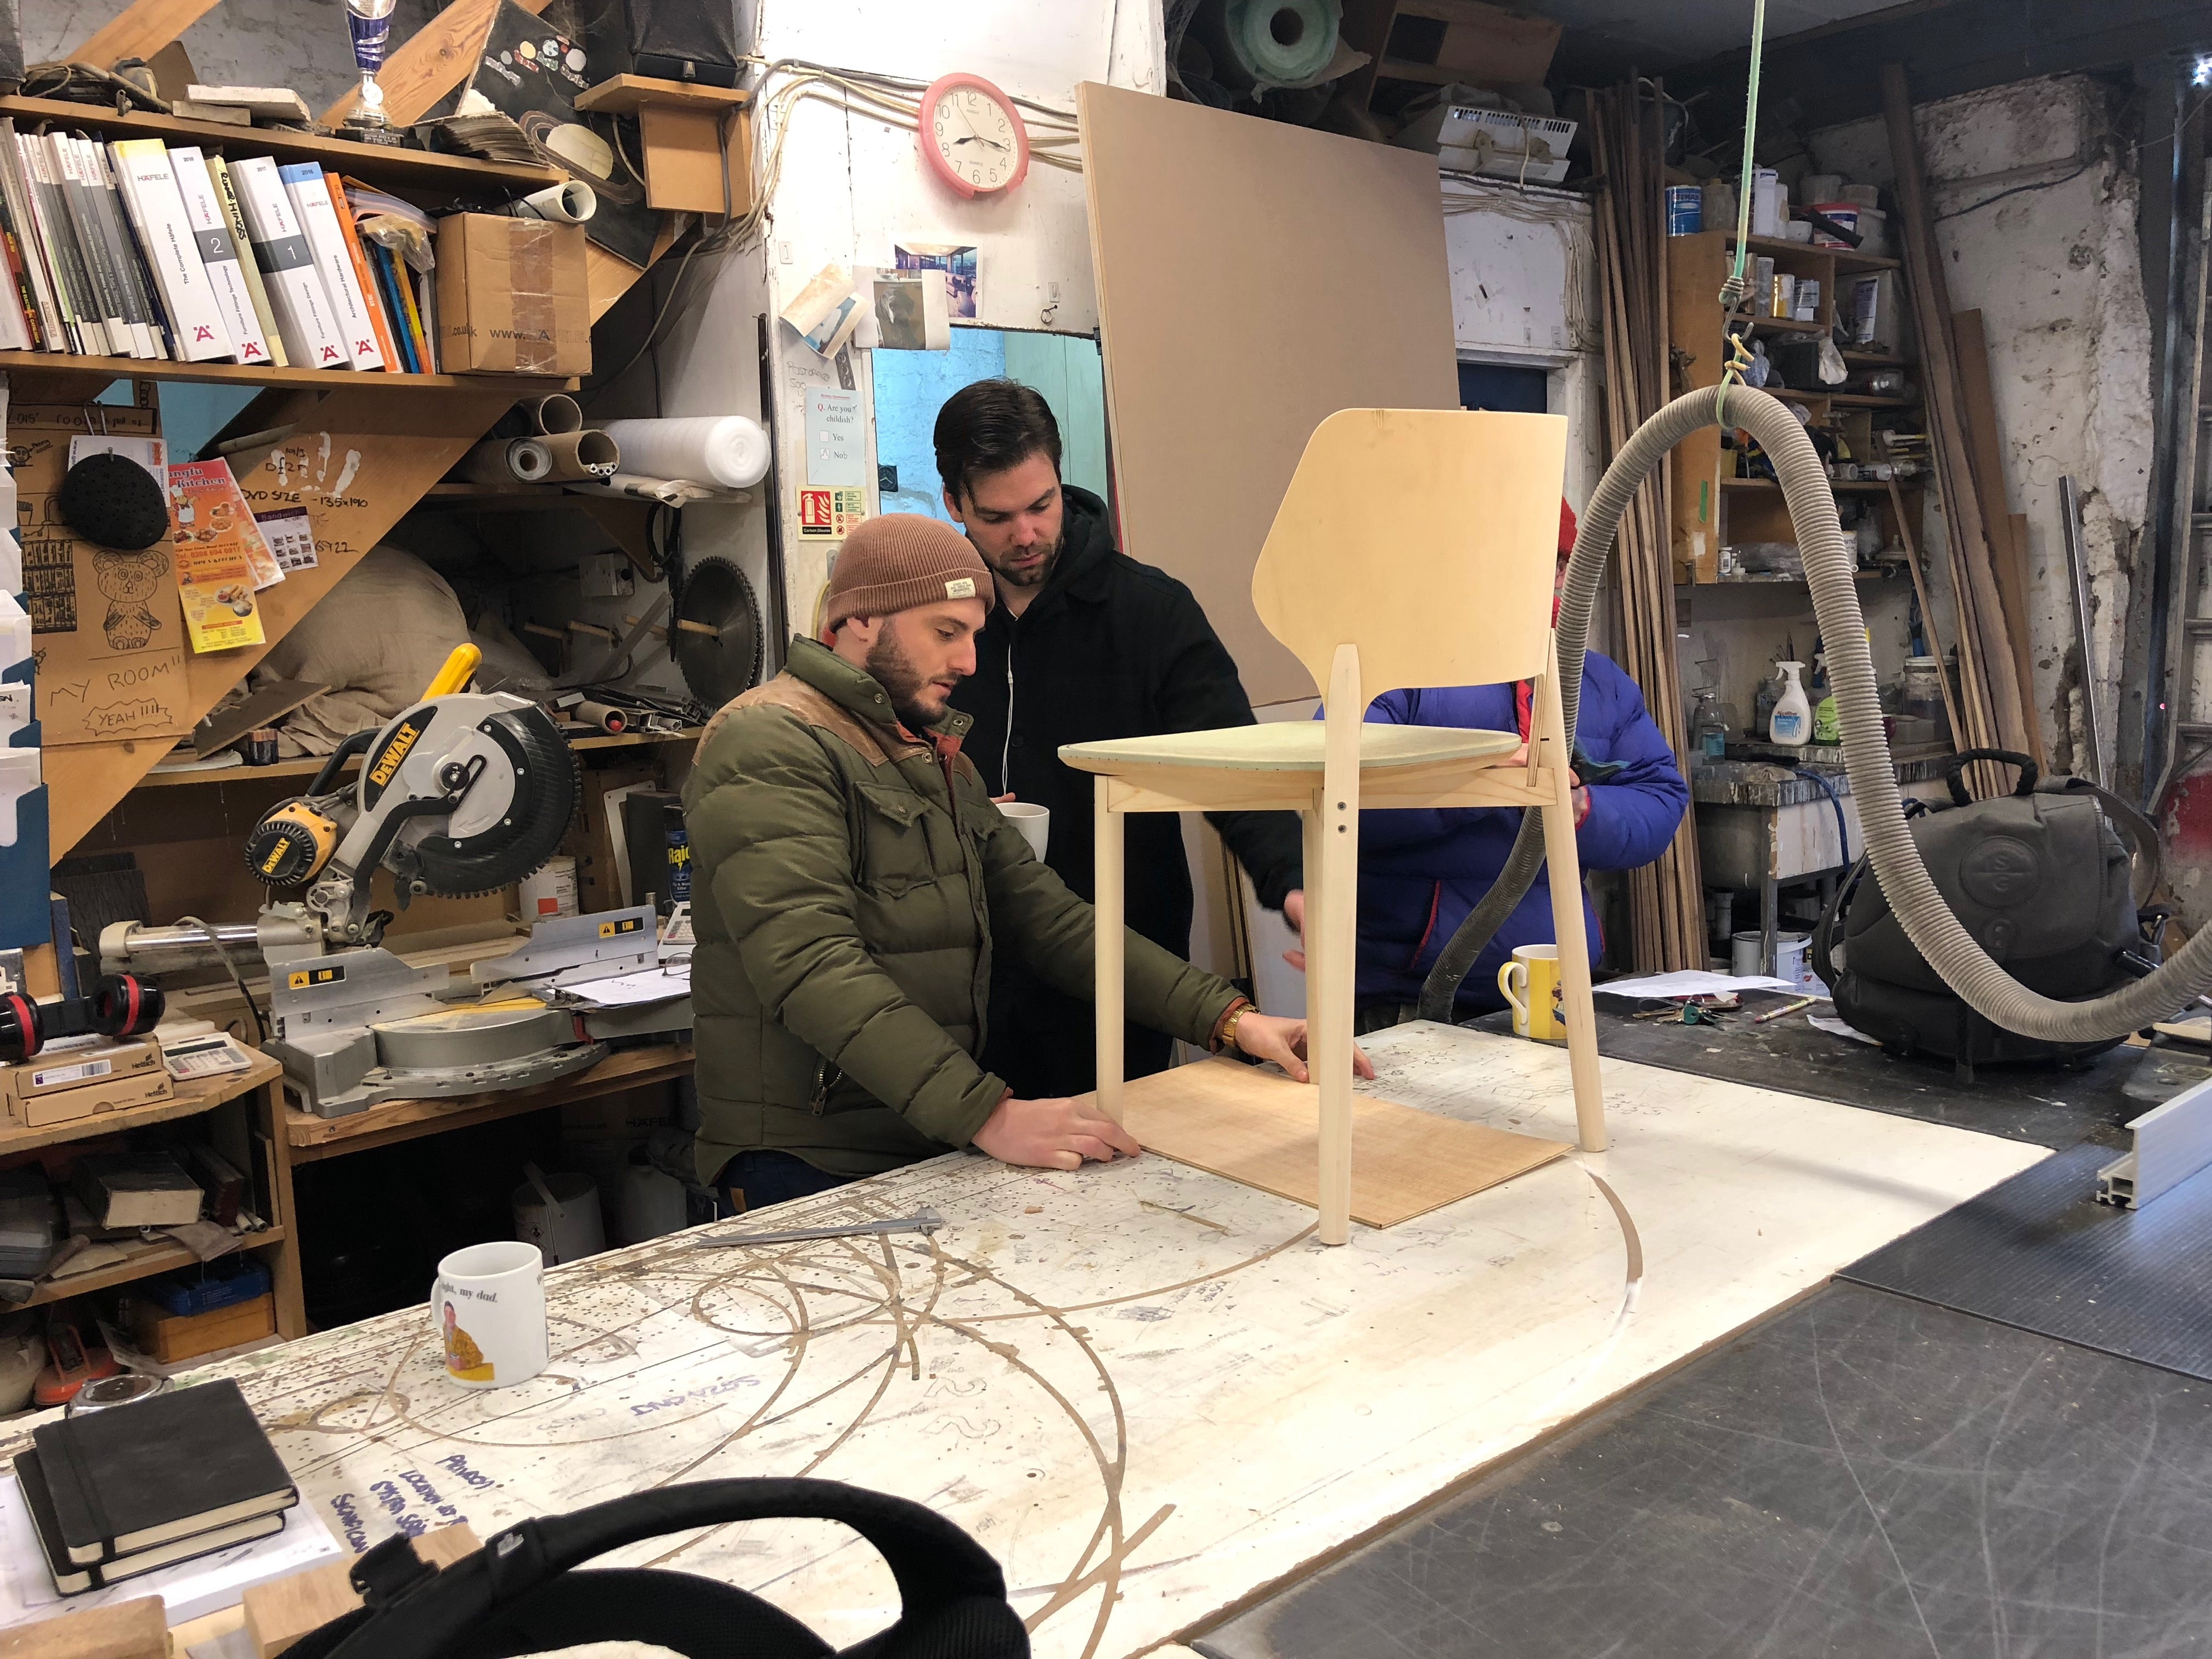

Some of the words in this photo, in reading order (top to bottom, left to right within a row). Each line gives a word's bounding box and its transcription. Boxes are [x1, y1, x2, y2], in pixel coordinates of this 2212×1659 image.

[950, 93, 958, 106] 11
[966, 91, 977, 106] 12
[938, 104, 950, 119] 10
[987, 103, 991, 116] 1
[935, 122, 943, 137] 9
[998, 119, 1005, 133] 2
[942, 142, 950, 157] 8
[1003, 138, 1011, 152] 3
[955, 160, 962, 173] 7
[1000, 157, 1007, 171] 4
[973, 170, 980, 184] 6
[990, 168, 997, 182] 5
[167, 223, 176, 242] Häfele
[211, 238, 224, 253] 2
[287, 245, 296, 260] 1
[173, 244, 185, 272] Complete
[334, 255, 346, 282] Hardware
[222, 266, 235, 294] Technology
[302, 282, 311, 299] Design
[230, 293, 240, 313] Fittings
[307, 298, 317, 317] Fittings
[341, 281, 357, 319] Architectural
[235, 312, 247, 335] Furniture
[313, 317, 325, 338] Furniture
[817, 403, 825, 412] Q.
[840, 405, 851, 414] you
[826, 415, 854, 424] childish?
[832, 433, 844, 442] Yes
[834, 450, 848, 459] Nob
[177, 477, 226, 488] Kitchen
[272, 490, 301, 502] SIZE
[261, 510, 300, 521] Sandwich
[50, 679, 90, 707] MY
[132, 1059, 156, 1069] Hettich
[145, 1088, 168, 1098] Hettich
[460, 1288, 473, 1299] my
[476, 1290, 498, 1303] dad.
